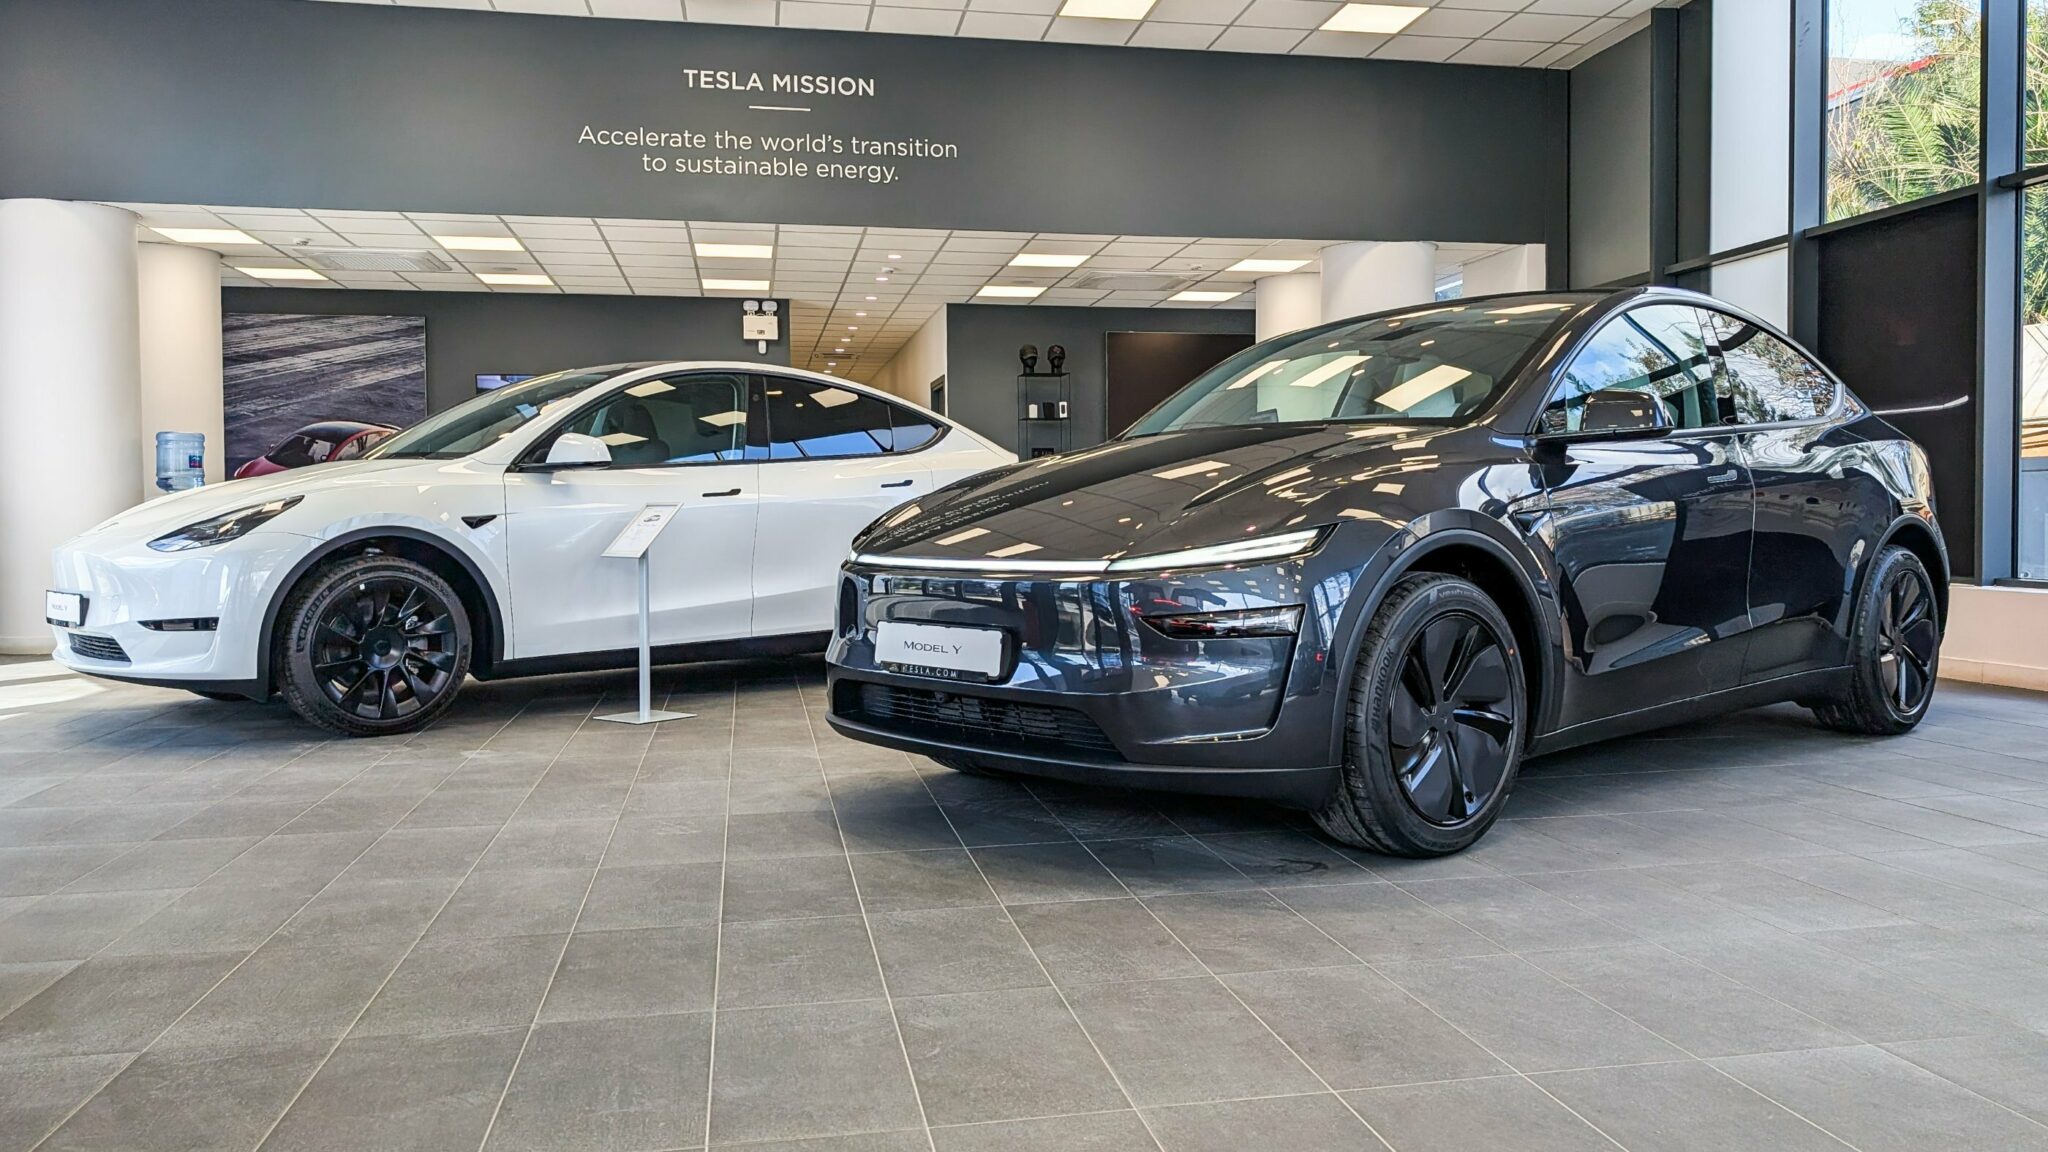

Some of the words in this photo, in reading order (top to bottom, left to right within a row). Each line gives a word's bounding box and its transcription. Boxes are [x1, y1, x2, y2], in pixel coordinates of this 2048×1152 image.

[683, 69, 764, 92] TESLA
[772, 73, 875, 97] MISSION
[578, 125, 706, 149] Accelerate
[714, 130, 753, 151] the
[760, 133, 843, 155] world's
[851, 136, 958, 158] transition
[641, 153, 667, 173] to
[675, 155, 808, 178] sustainable
[816, 163, 899, 184] energy.
[903, 640, 949, 654] MODEL
[952, 644, 962, 655] Y
[903, 664, 957, 678] TESLA.COM
